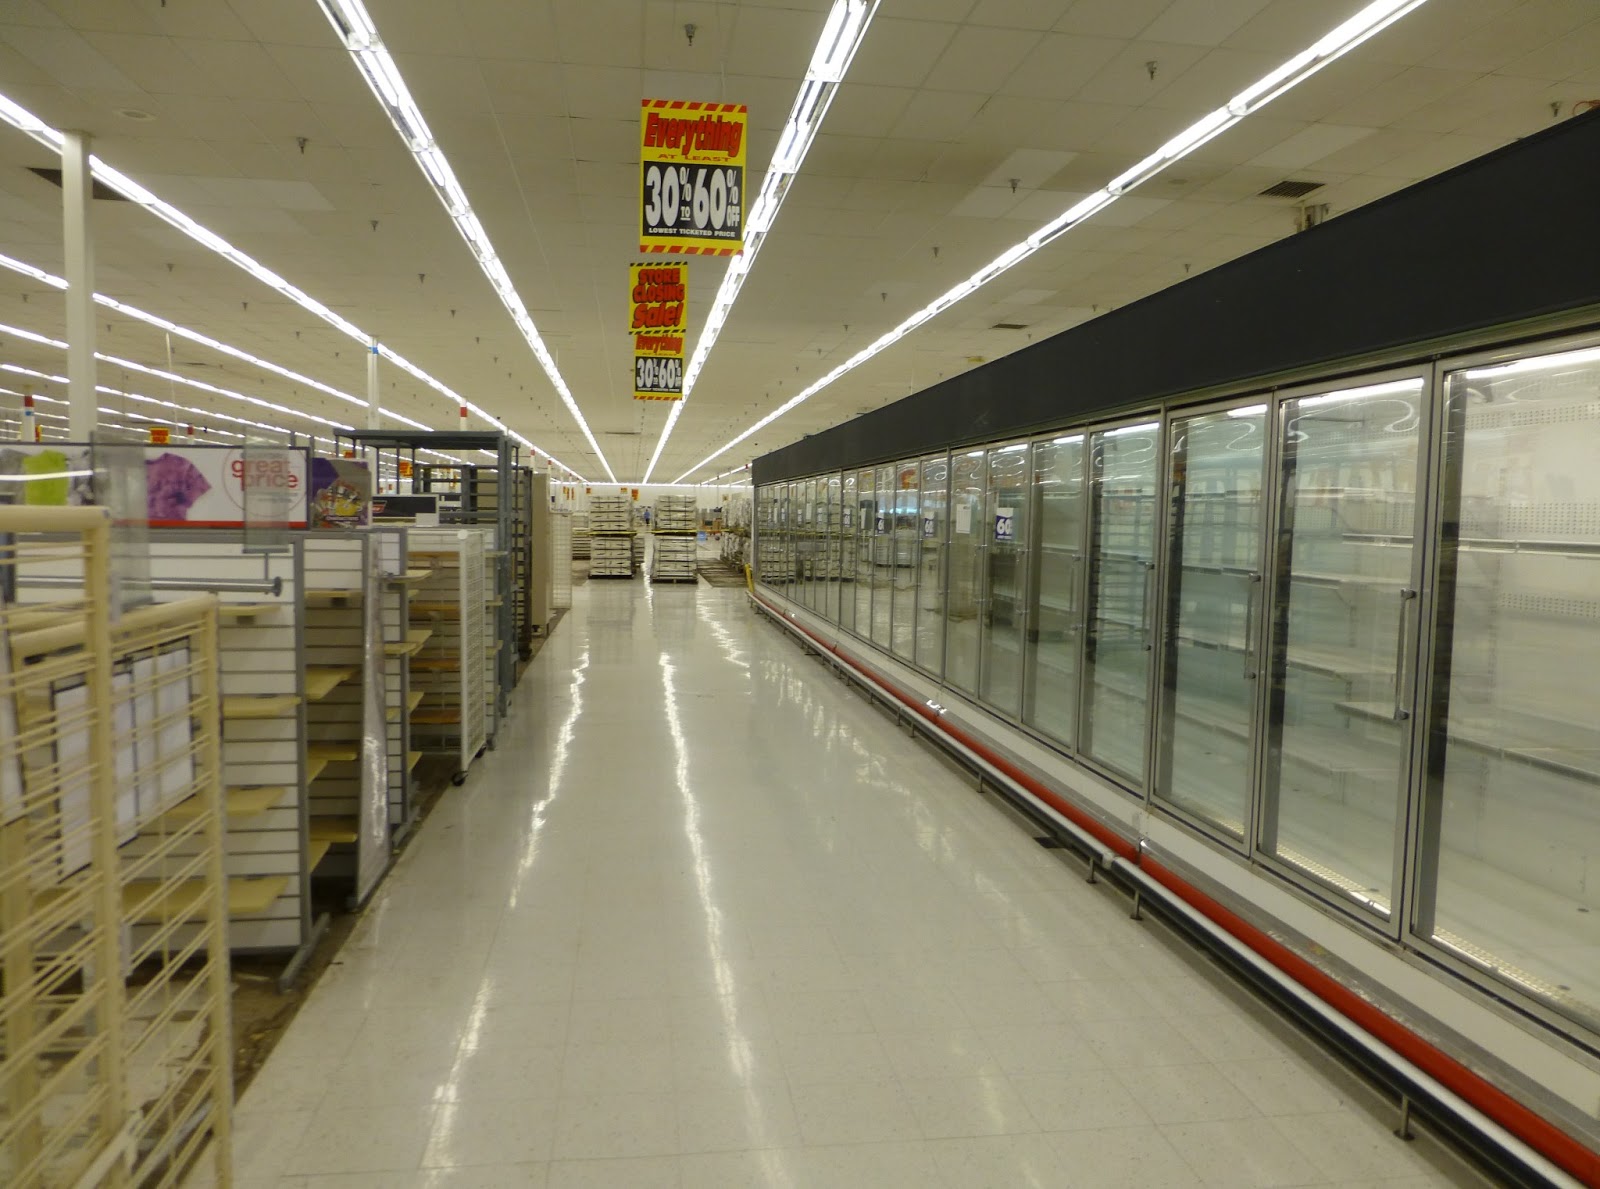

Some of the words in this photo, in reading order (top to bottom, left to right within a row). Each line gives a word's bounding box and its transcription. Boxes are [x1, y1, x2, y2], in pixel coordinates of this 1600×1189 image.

[644, 112, 743, 157] Everything
[726, 205, 740, 227] OFF
[679, 228, 712, 236] TICKETED
[638, 267, 681, 285] STORE
[633, 283, 685, 304] CLOSING
[632, 301, 684, 329] Sale!
